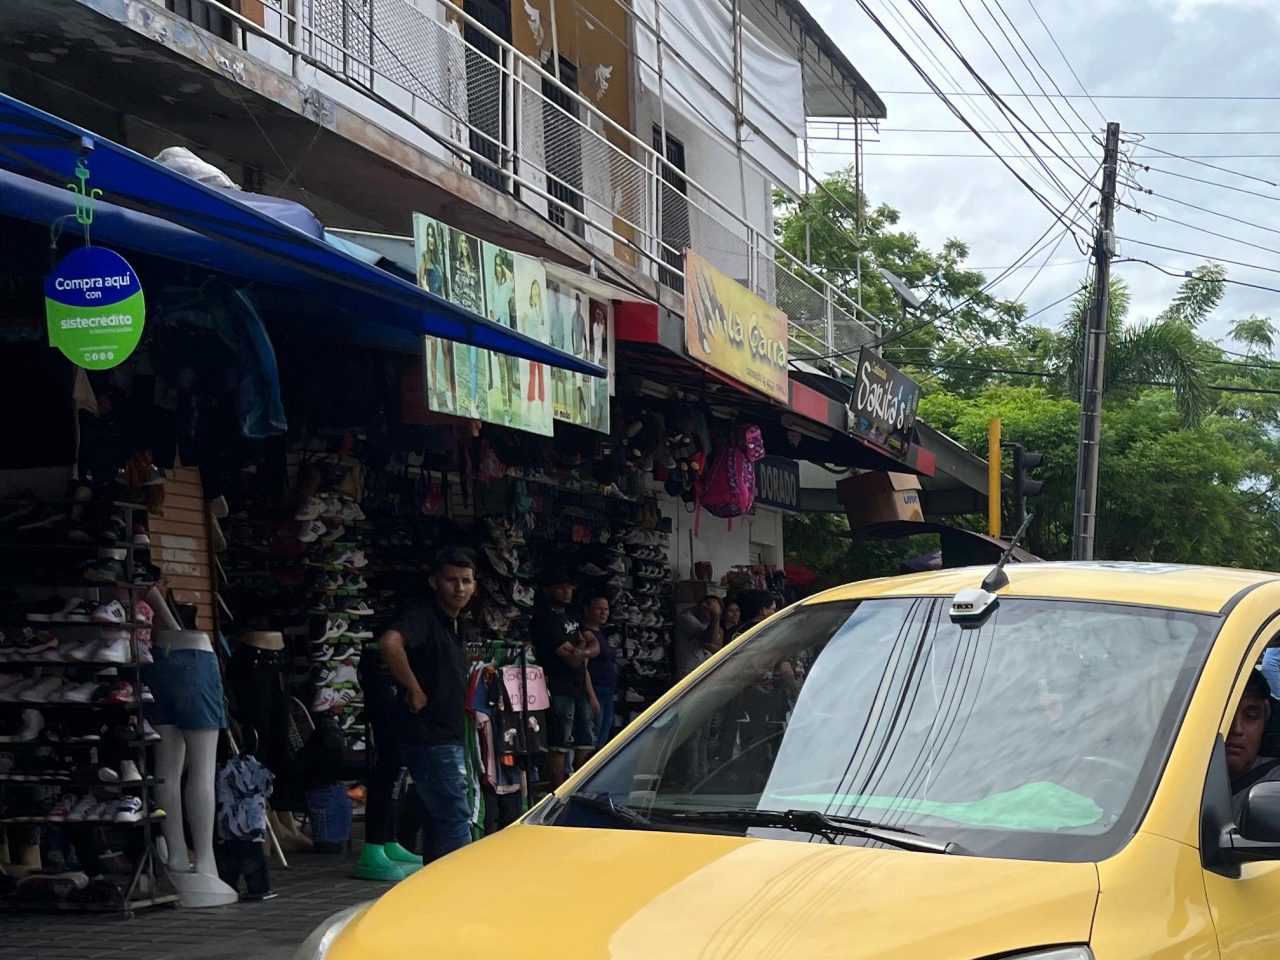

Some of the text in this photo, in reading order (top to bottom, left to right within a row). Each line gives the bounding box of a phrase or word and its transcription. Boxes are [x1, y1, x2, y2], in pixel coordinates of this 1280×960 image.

[55, 271, 130, 291] Compra aquí
[85, 291, 101, 299] con
[760, 464, 796, 506] DORADO
